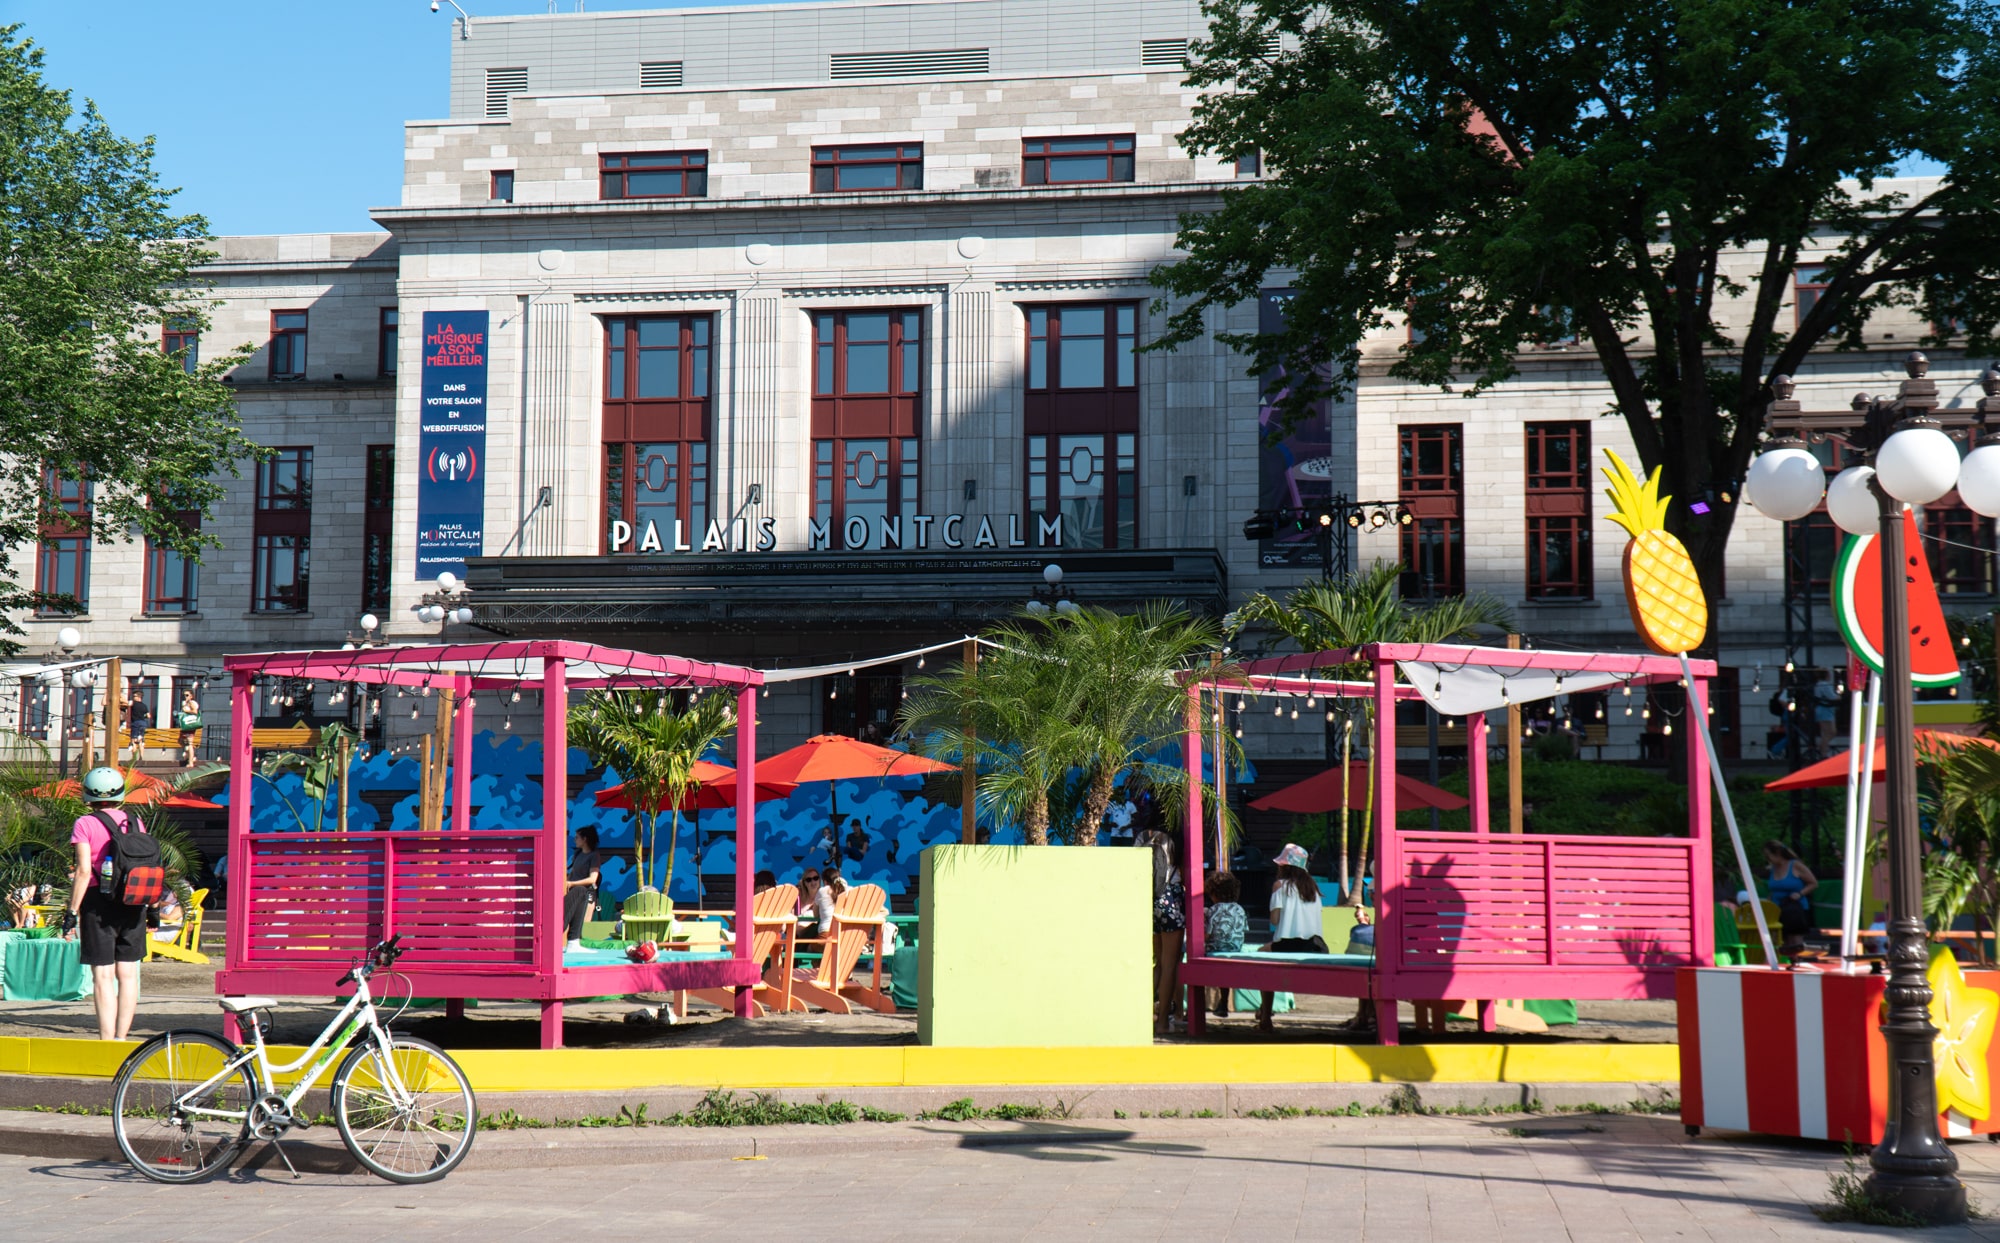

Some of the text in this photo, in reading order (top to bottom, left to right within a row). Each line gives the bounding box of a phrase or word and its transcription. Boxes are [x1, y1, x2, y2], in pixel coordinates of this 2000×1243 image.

[437, 323, 454, 334] LA
[427, 333, 483, 345] MUSIQUE
[447, 344, 475, 355] SON
[426, 355, 483, 366] MEILLEUR
[454, 397, 482, 405] SALON
[422, 424, 485, 432] WEBDIFFUSION
[612, 513, 1064, 552] PALAIS MONTCALM
